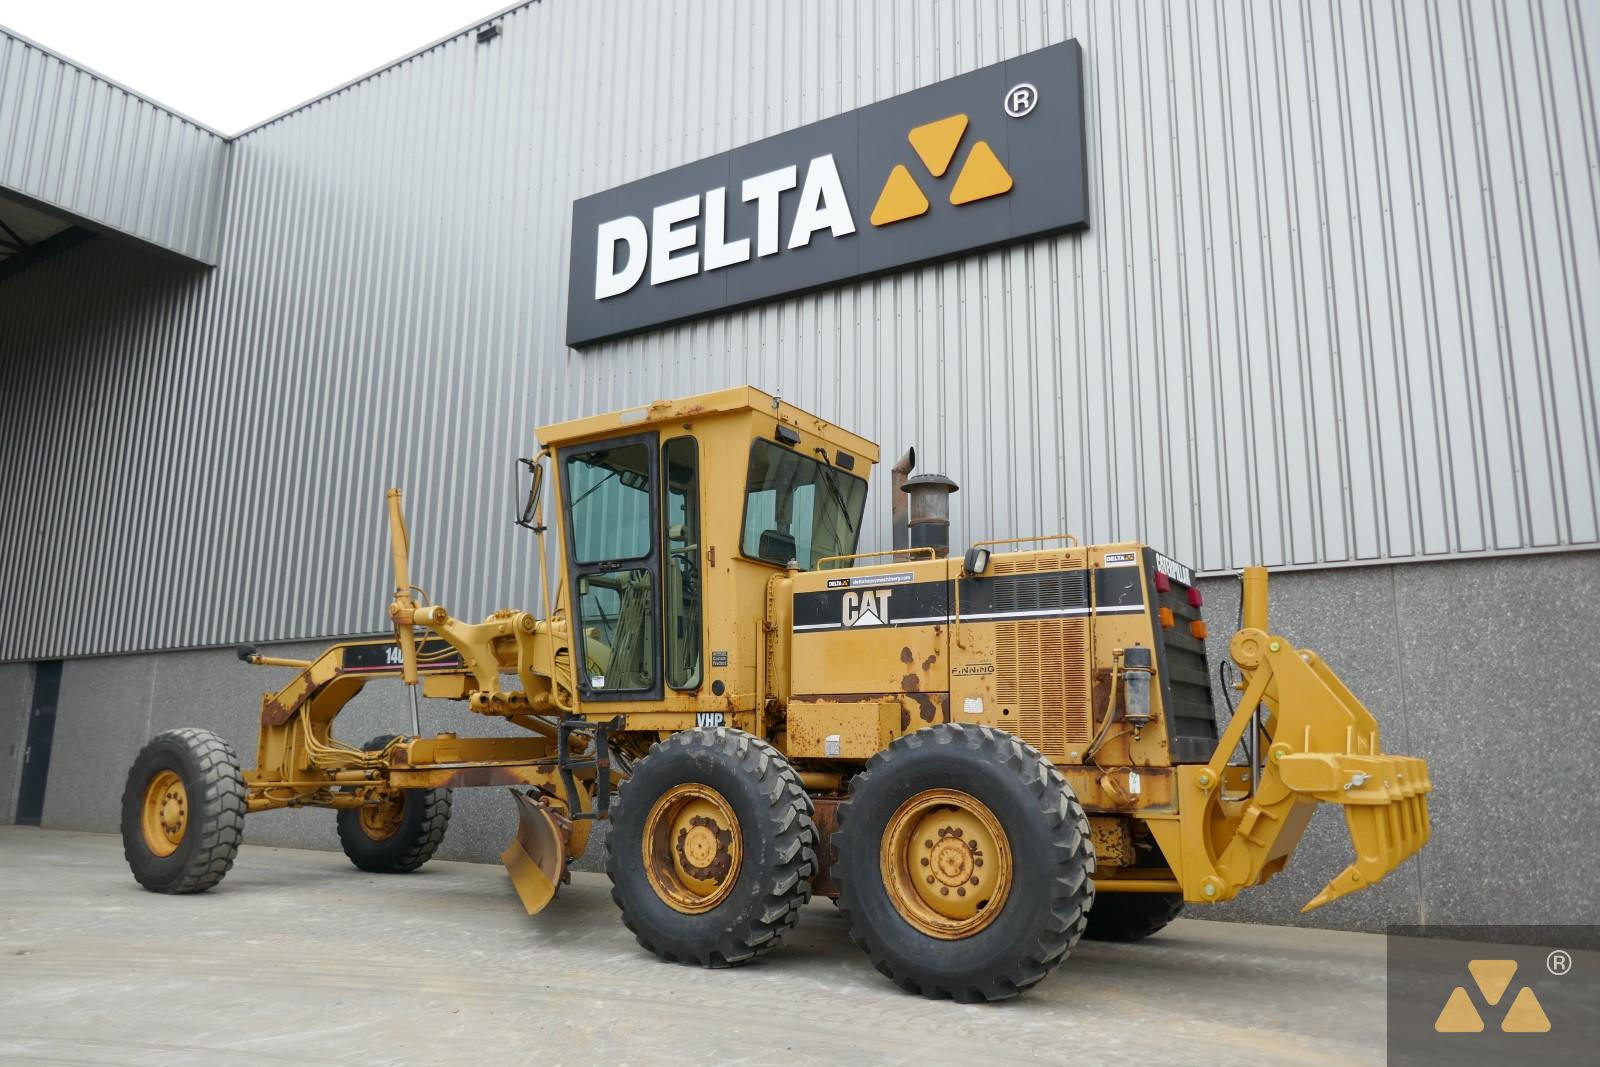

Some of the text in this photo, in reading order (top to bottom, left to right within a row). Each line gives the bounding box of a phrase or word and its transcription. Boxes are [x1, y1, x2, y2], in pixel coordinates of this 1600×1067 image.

[594, 152, 856, 300] DELTA
[842, 589, 892, 627] CAT
[697, 713, 723, 727] VHP
